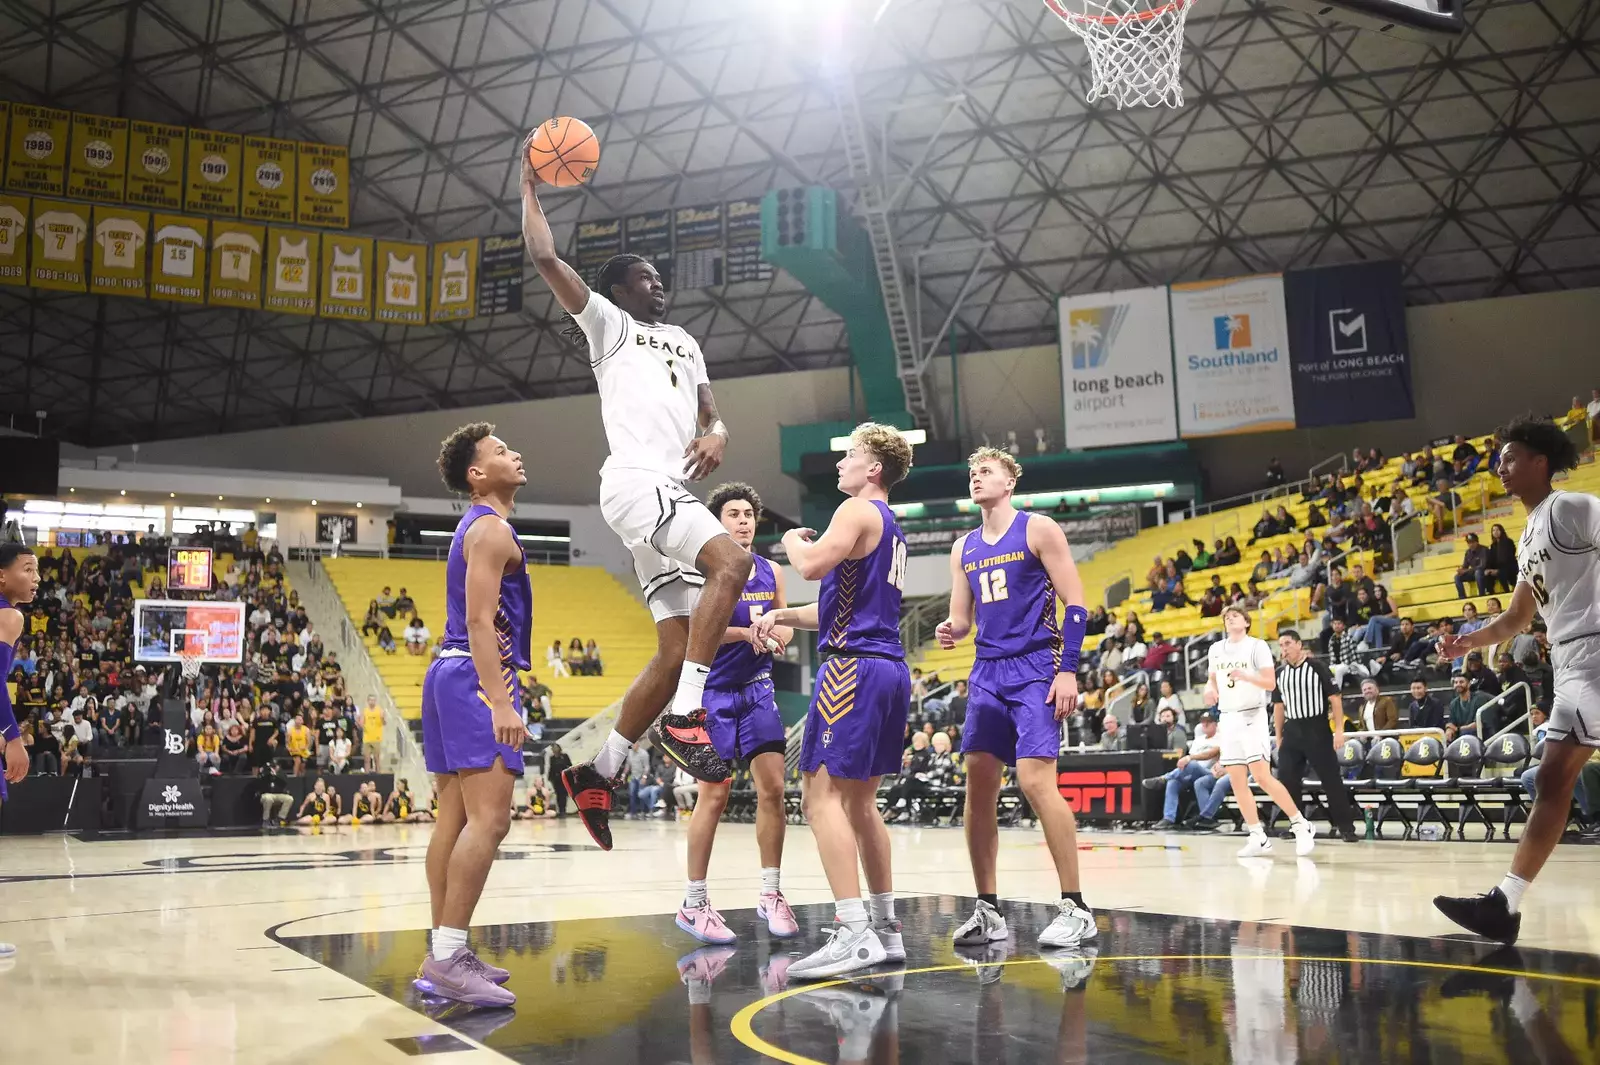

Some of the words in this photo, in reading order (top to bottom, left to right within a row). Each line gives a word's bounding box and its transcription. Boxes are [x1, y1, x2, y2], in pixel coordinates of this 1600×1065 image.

[14, 105, 37, 117] LONG
[40, 109, 68, 121] BEACH
[28, 118, 53, 129] STATE
[88, 127, 113, 139] STATE
[25, 140, 53, 151] 1989
[85, 147, 113, 161] 1993
[9, 178, 62, 193] CHAMPIONS
[56, 234, 66, 250] 7
[114, 241, 125, 257] 2
[280, 265, 303, 284] 42
[636, 333, 695, 364] BEACH
[1188, 348, 1279, 371] Southland
[1320, 361, 1330, 371] of
[1333, 357, 1364, 370] LONG
[1366, 353, 1405, 366] BEACH
[1072, 378, 1110, 394] long
[1114, 371, 1164, 389] beach
[1074, 394, 1125, 412] airport
[887, 534, 907, 591] 10
[963, 560, 978, 573] CAL
[979, 551, 1025, 570] LUTHERAN
[979, 567, 1009, 604] 12
[164, 728, 185, 755] LB
[1056, 770, 1132, 814] SPN
[148, 803, 172, 812] Dignity
[172, 802, 194, 811] Health
